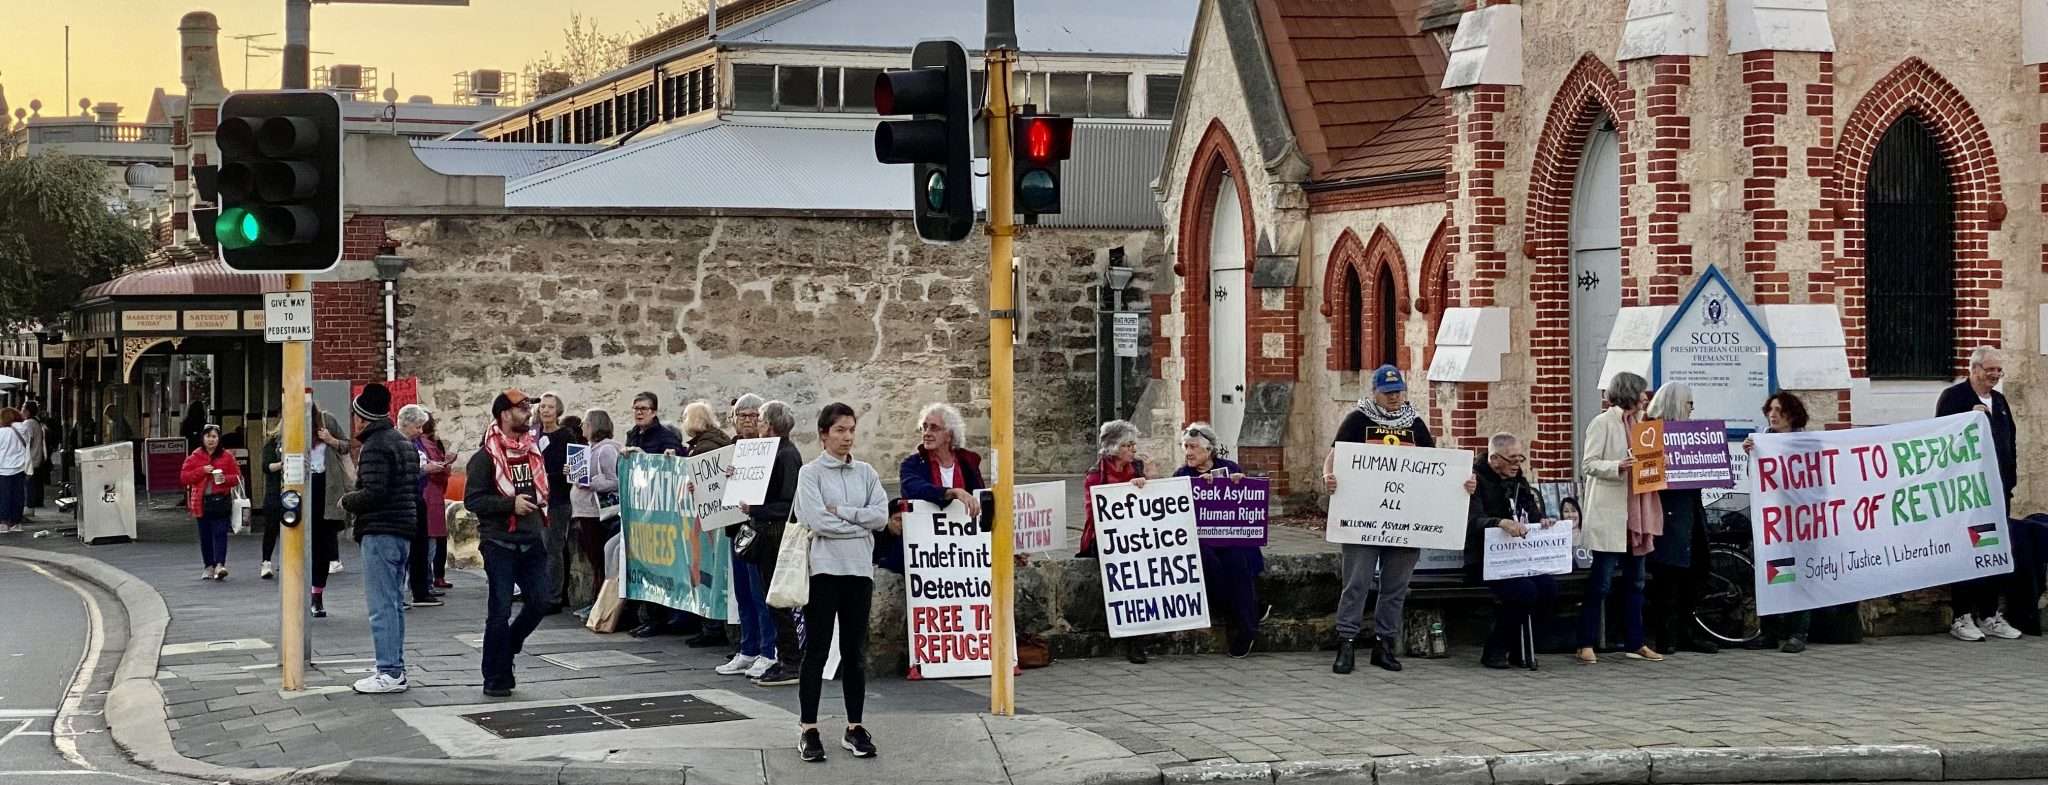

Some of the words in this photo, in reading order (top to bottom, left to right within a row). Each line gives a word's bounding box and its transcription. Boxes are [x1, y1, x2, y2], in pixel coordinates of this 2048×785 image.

[271, 299, 287, 308] GIVE
[290, 298, 305, 307] WAY
[284, 312, 294, 320] TO
[268, 326, 310, 335] PEDESTRIANS
[1691, 332, 1740, 344] SCOTS
[1664, 428, 1724, 449] ompassion
[737, 442, 774, 457] SUPPORT
[1675, 450, 1727, 466] Punishment
[1758, 448, 1840, 492] RIGHT
[1850, 444, 1888, 481] TO
[1892, 423, 1982, 478] REFUGE
[692, 454, 726, 484] HONK
[1352, 454, 1396, 472] HUMAN
[1400, 458, 1446, 476] RIGHTS
[708, 482, 720, 493] FOR
[1193, 486, 1221, 500] Seek
[1224, 486, 1265, 504] Asylum
[1384, 481, 1405, 494] FOR
[1096, 493, 1190, 522] Refugee
[1380, 498, 1401, 510] ALL
[1762, 499, 1845, 545] RIGHT
[1853, 493, 1886, 532] OF
[1892, 472, 1992, 526] RETURN
[1200, 507, 1235, 520] Human
[1238, 507, 1265, 524] Right
[932, 513, 977, 536] End
[1197, 527, 1263, 537] dmothers4refugees
[1340, 519, 1377, 529] INCLUDING
[1382, 520, 1410, 531] ASYLUM
[1412, 522, 1444, 534] SEEKERS
[1103, 527, 1188, 555] Justice
[1361, 534, 1408, 544] REFUGEES
[1490, 538, 1567, 552] COMPASSIONATE
[908, 543, 992, 568] Indefinit
[1805, 557, 1838, 580] Safety
[1848, 552, 1882, 572] Justice
[1892, 538, 1951, 562] Liberation
[1974, 552, 2008, 568] RRAN
[1105, 554, 1200, 592] RELEASE
[910, 573, 992, 599] Detentio
[1108, 598, 1160, 626] THEM
[1162, 592, 1202, 619] NOW
[913, 605, 964, 633] FREE
[970, 604, 992, 630] TH
